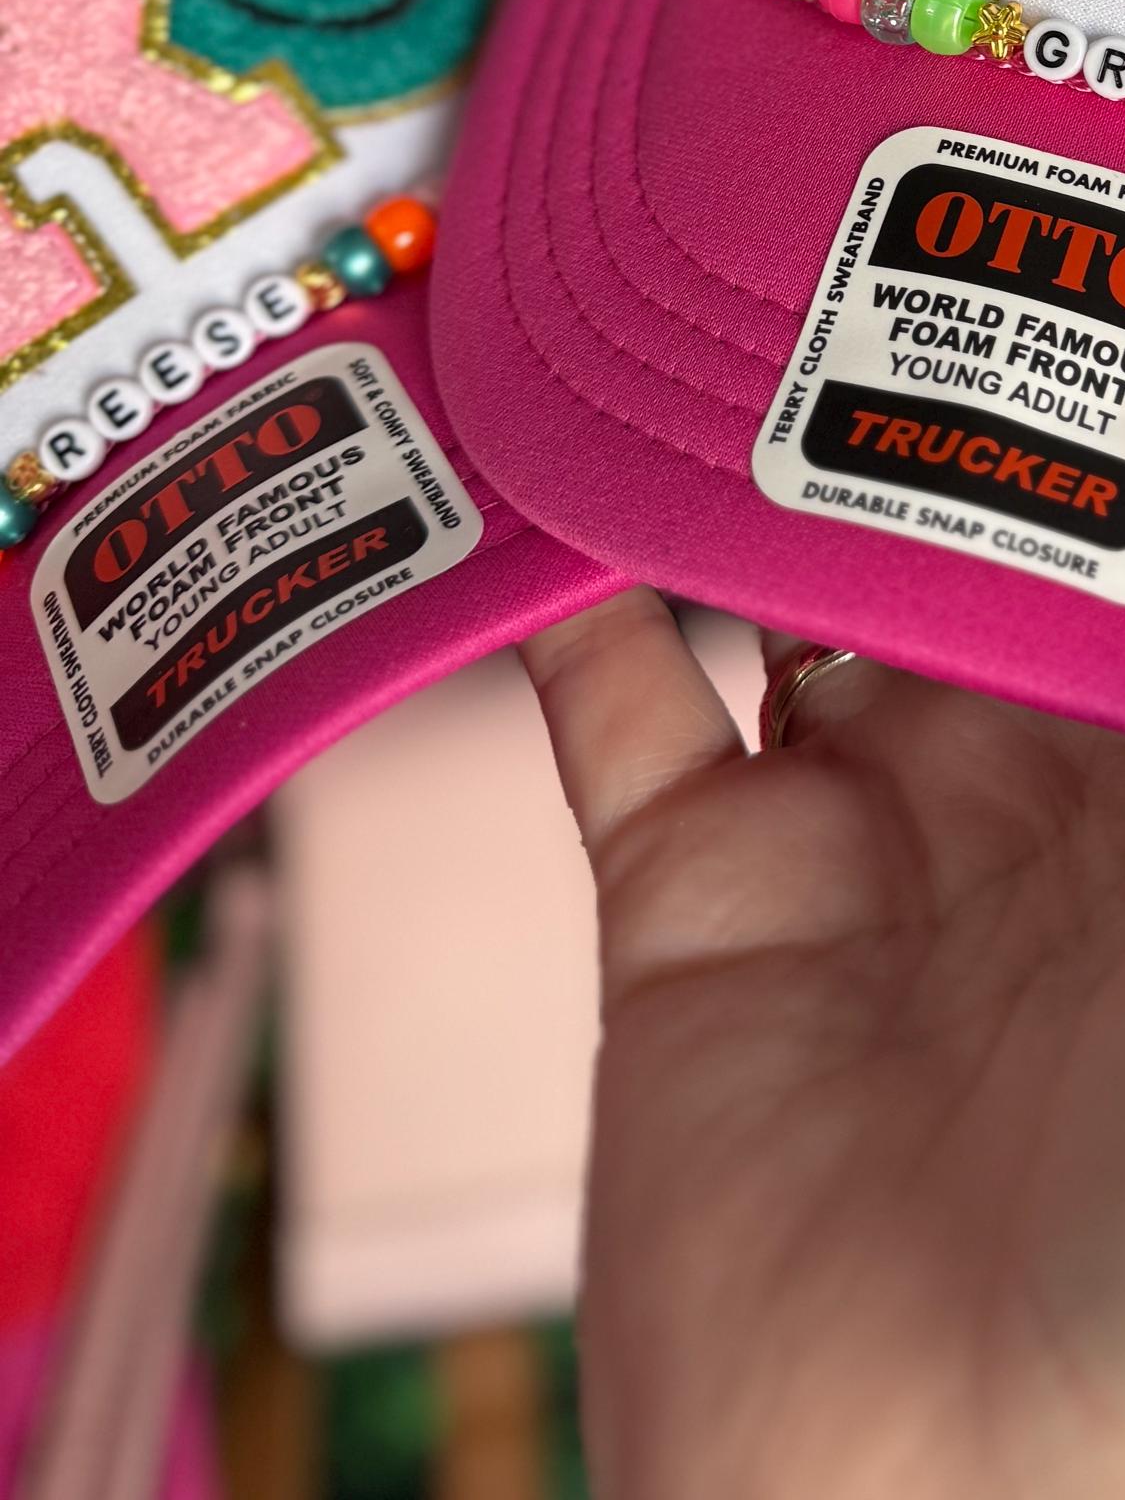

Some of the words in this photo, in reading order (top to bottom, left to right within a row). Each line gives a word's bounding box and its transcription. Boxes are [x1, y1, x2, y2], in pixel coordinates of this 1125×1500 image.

[936, 139, 1039, 176] PREMIUM
[1045, 165, 1111, 195] FOAM
[768, 380, 809, 445] TERRY
[799, 309, 839, 377] CLOTH
[827, 177, 886, 304] SWEATBAND
[873, 283, 1005, 330] WORLD
[888, 317, 996, 359] FOAM
[48, 285, 297, 470] REESE
[348, 358, 378, 387] SOFT
[366, 388, 384, 402] &
[890, 352, 1003, 395] YOUNG
[1007, 382, 1117, 436] ADULT
[72, 462, 158, 536] PREMIUM
[162, 418, 222, 461] FOAM
[226, 372, 298, 418] FABRIC
[374, 400, 414, 447] COMFY
[847, 410, 1119, 516] TRUCKER
[401, 447, 462, 529] SWEATBAND
[801, 481, 910, 522] DURABLE
[916, 508, 985, 541] SNAP
[991, 529, 1100, 579] CLOSURE
[98, 536, 209, 642] WORLD
[217, 445, 366, 536] FAMOUS
[128, 551, 217, 641] FOAM
[224, 474, 345, 554] FRONT
[144, 561, 240, 651] YOUNG
[248, 500, 346, 564] ADULT
[43, 591, 82, 679] SWEATBAND
[146, 525, 389, 709] TRUCKER
[70, 675, 98, 727] CLOTH
[146, 677, 238, 766] DURABLE
[242, 628, 305, 676] SNAP
[309, 565, 415, 631] CLOSURE
[87, 727, 113, 778] TERRY
